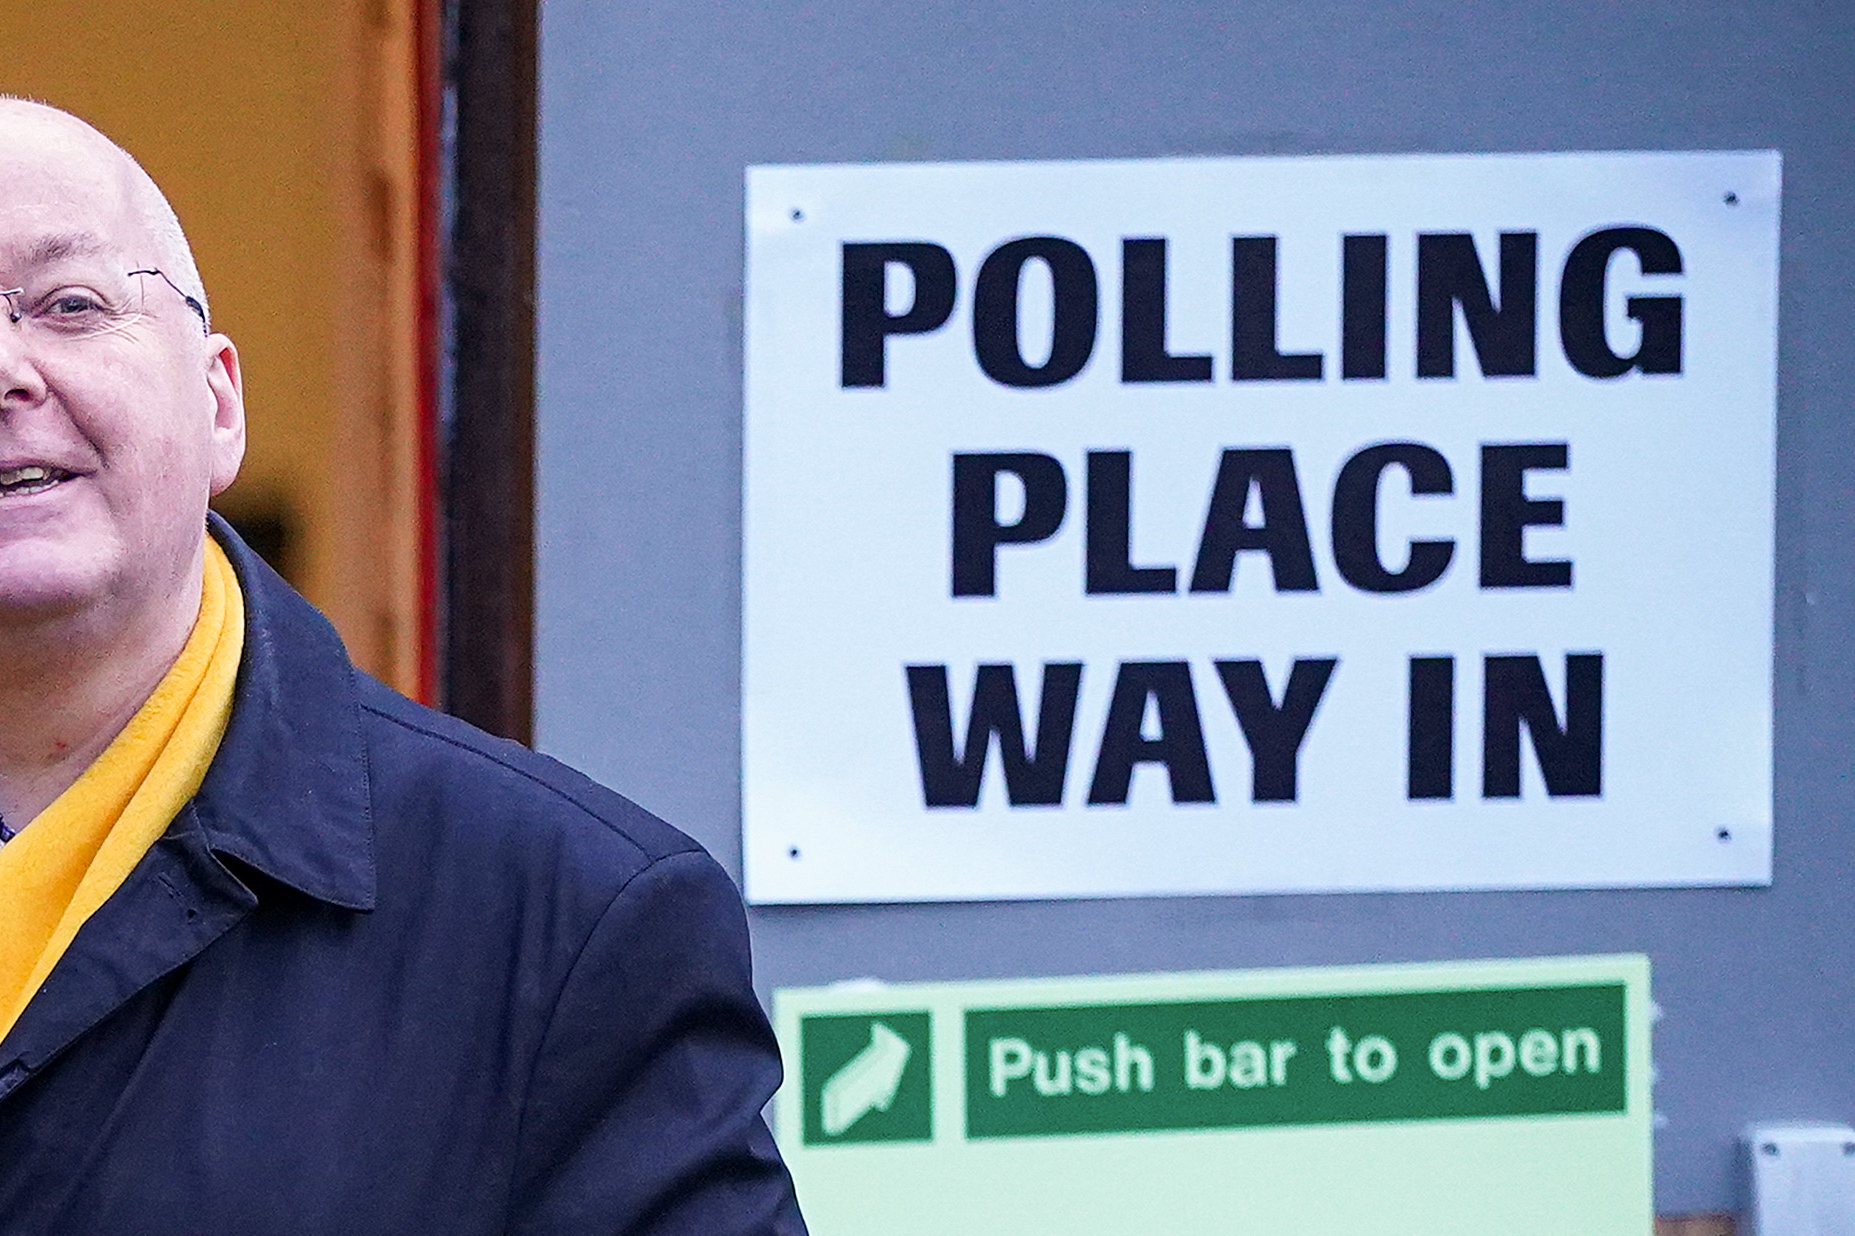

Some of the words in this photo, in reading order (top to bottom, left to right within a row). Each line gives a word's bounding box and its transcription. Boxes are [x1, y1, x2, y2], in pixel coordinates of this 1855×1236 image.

[840, 224, 1685, 389] POLLING
[951, 441, 1574, 599] PLACE
[904, 657, 1339, 810] WAY
[1406, 651, 1605, 801] IN
[988, 1031, 1155, 1098] Push
[1183, 1030, 1298, 1090] bar
[1327, 1027, 1397, 1083] to
[1429, 1027, 1602, 1090] open
